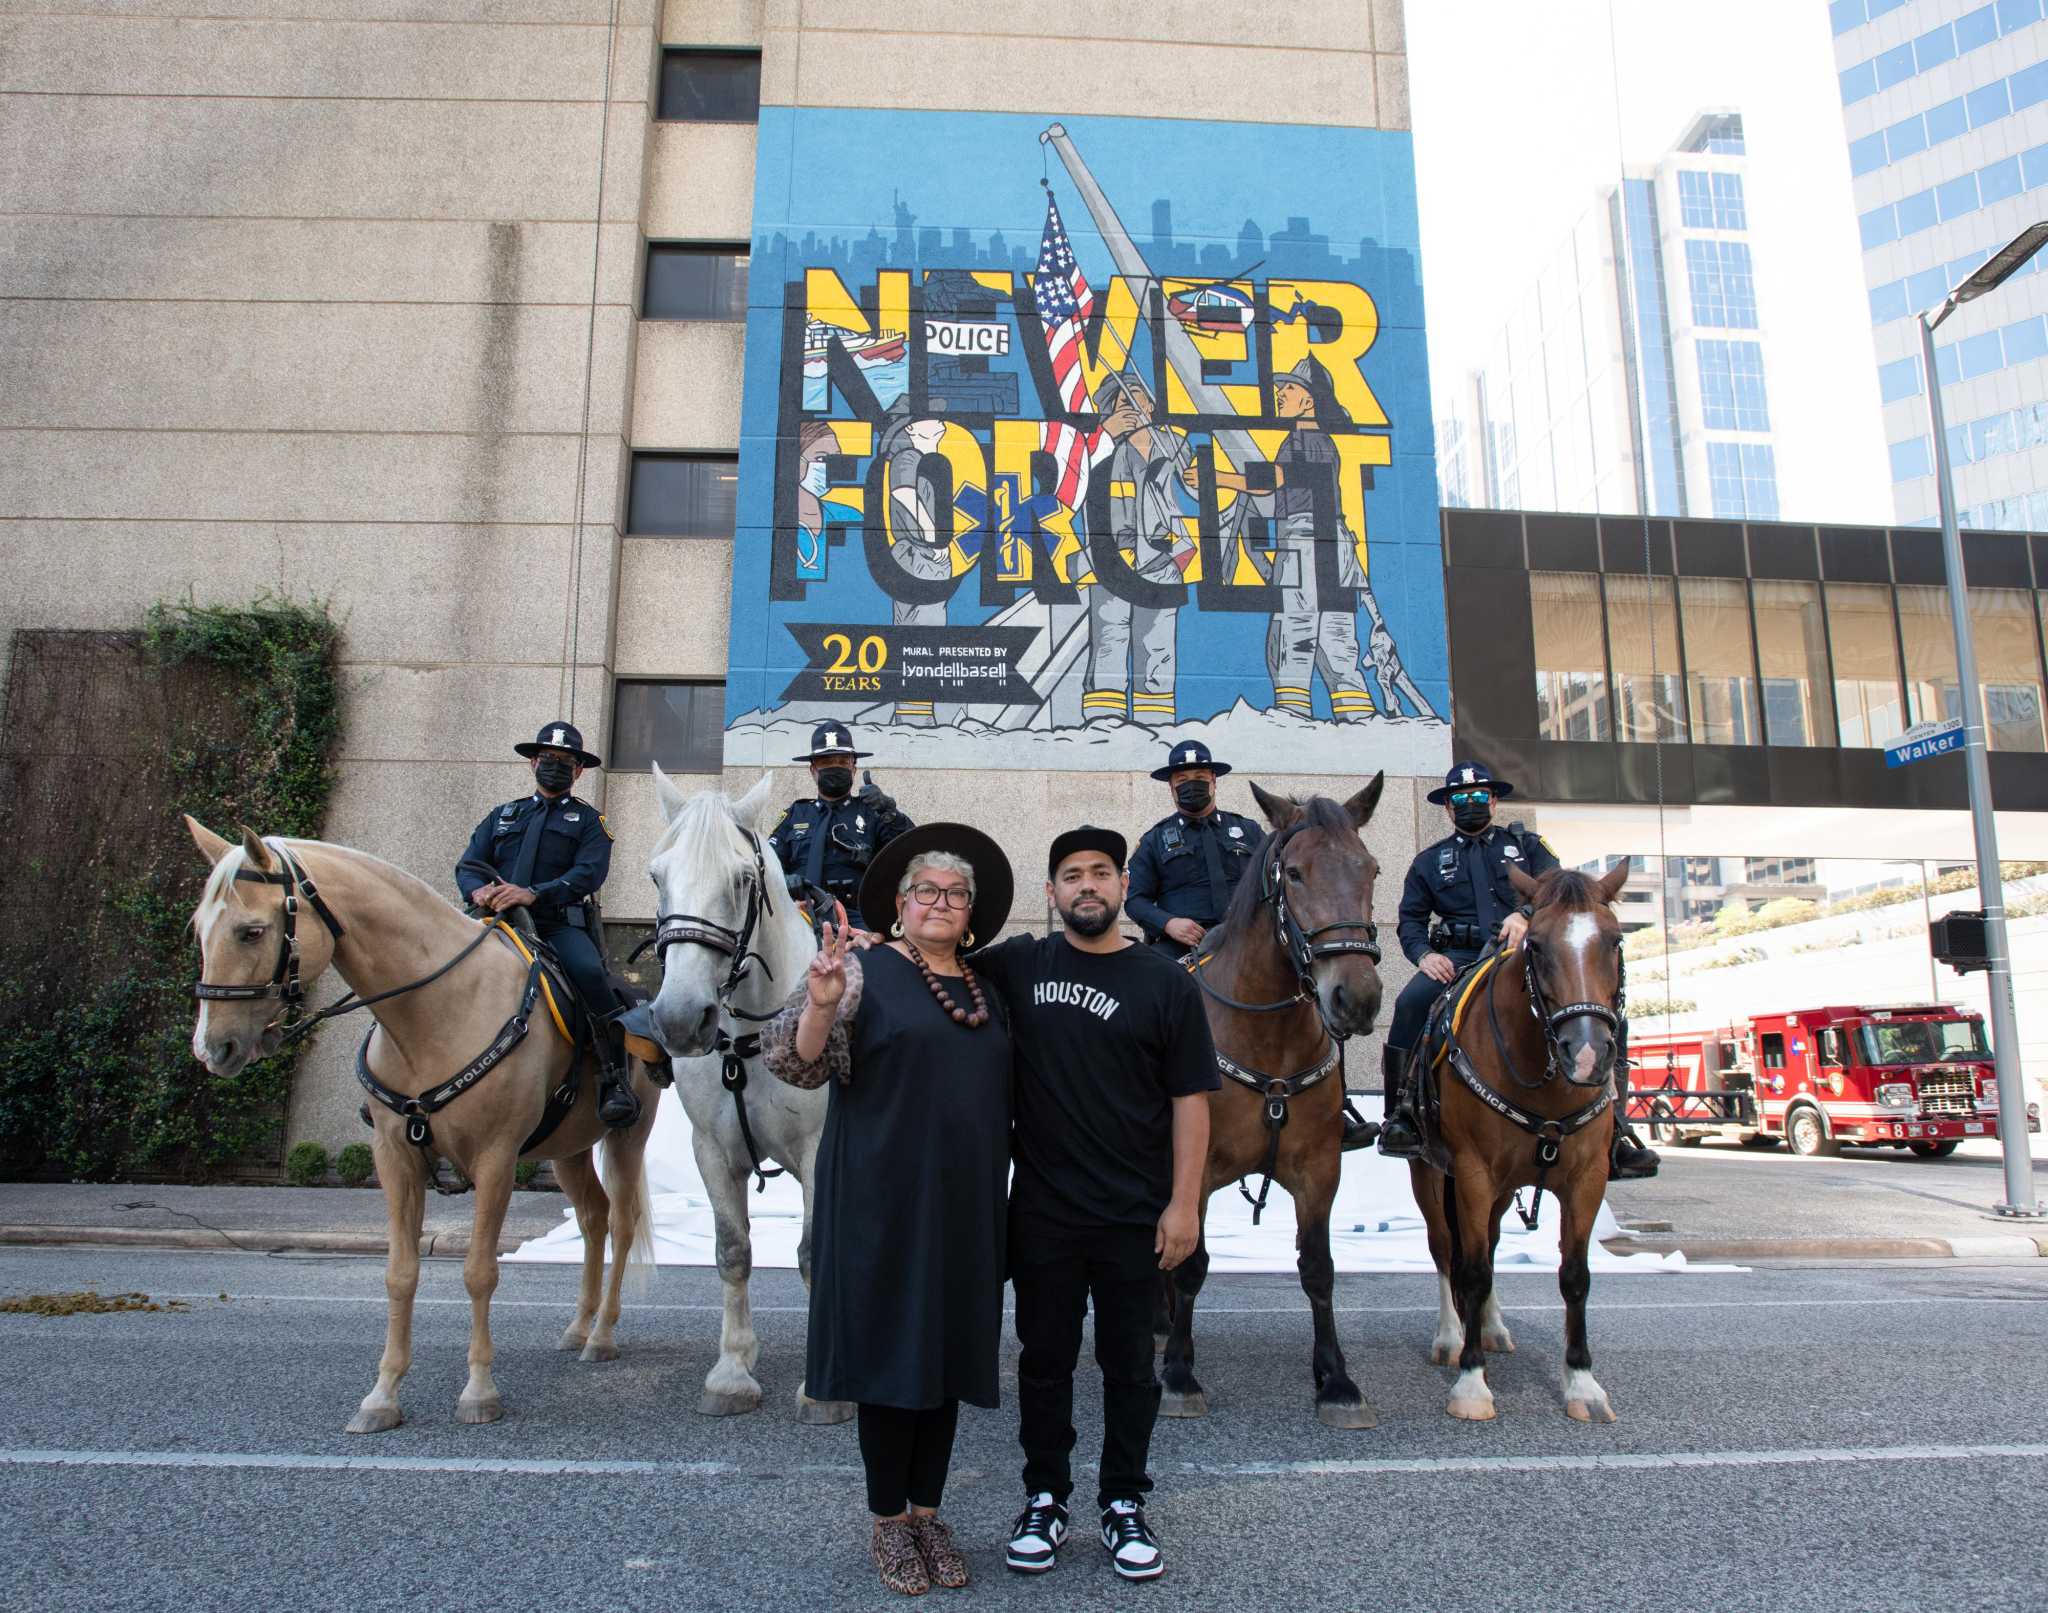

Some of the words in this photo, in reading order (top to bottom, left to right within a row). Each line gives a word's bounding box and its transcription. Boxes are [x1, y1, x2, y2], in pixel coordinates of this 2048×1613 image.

[802, 267, 1393, 428] NEVER
[925, 321, 1008, 354] POLICE
[796, 418, 1392, 588] FORGET
[822, 633, 888, 674] 20
[903, 646, 934, 656] MURAL
[939, 647, 992, 657] PRESENTED
[994, 647, 1007, 657] BY
[822, 676, 881, 691] YEARS
[902, 661, 1006, 678] lyondellbasell
[1896, 735, 1956, 763] Walker
[662, 929, 703, 940] POLICE
[1034, 981, 1120, 1021] HOUSTON
[1566, 1004, 1609, 1014] POLICE
[454, 1049, 499, 1089] POLICE
[1469, 1076, 1508, 1113] POLICE
[1894, 1123, 1903, 1138] 8
